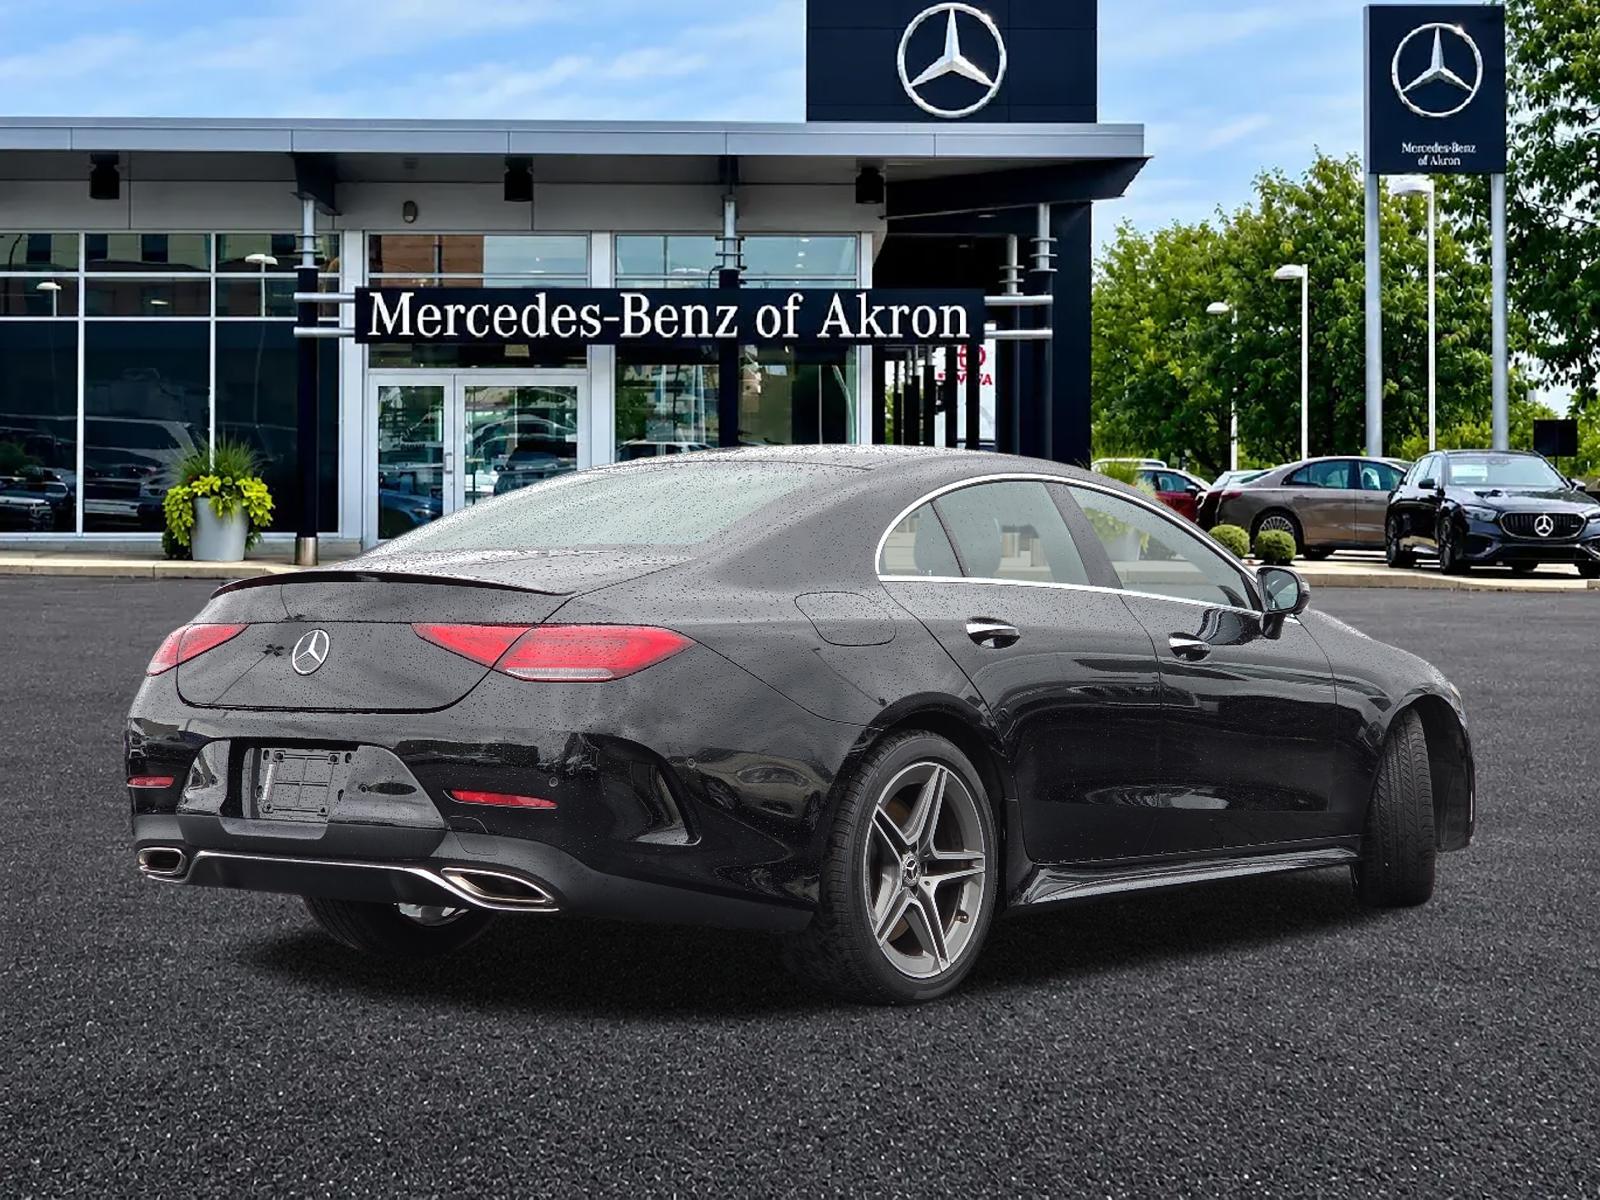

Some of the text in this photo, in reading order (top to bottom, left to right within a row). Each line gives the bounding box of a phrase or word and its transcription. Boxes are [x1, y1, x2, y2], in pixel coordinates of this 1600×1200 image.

[1401, 141, 1476, 154] Mercedes-Benz
[1417, 154, 1461, 166] of Akron
[367, 290, 971, 338] Mercedes-Benz of Akron
